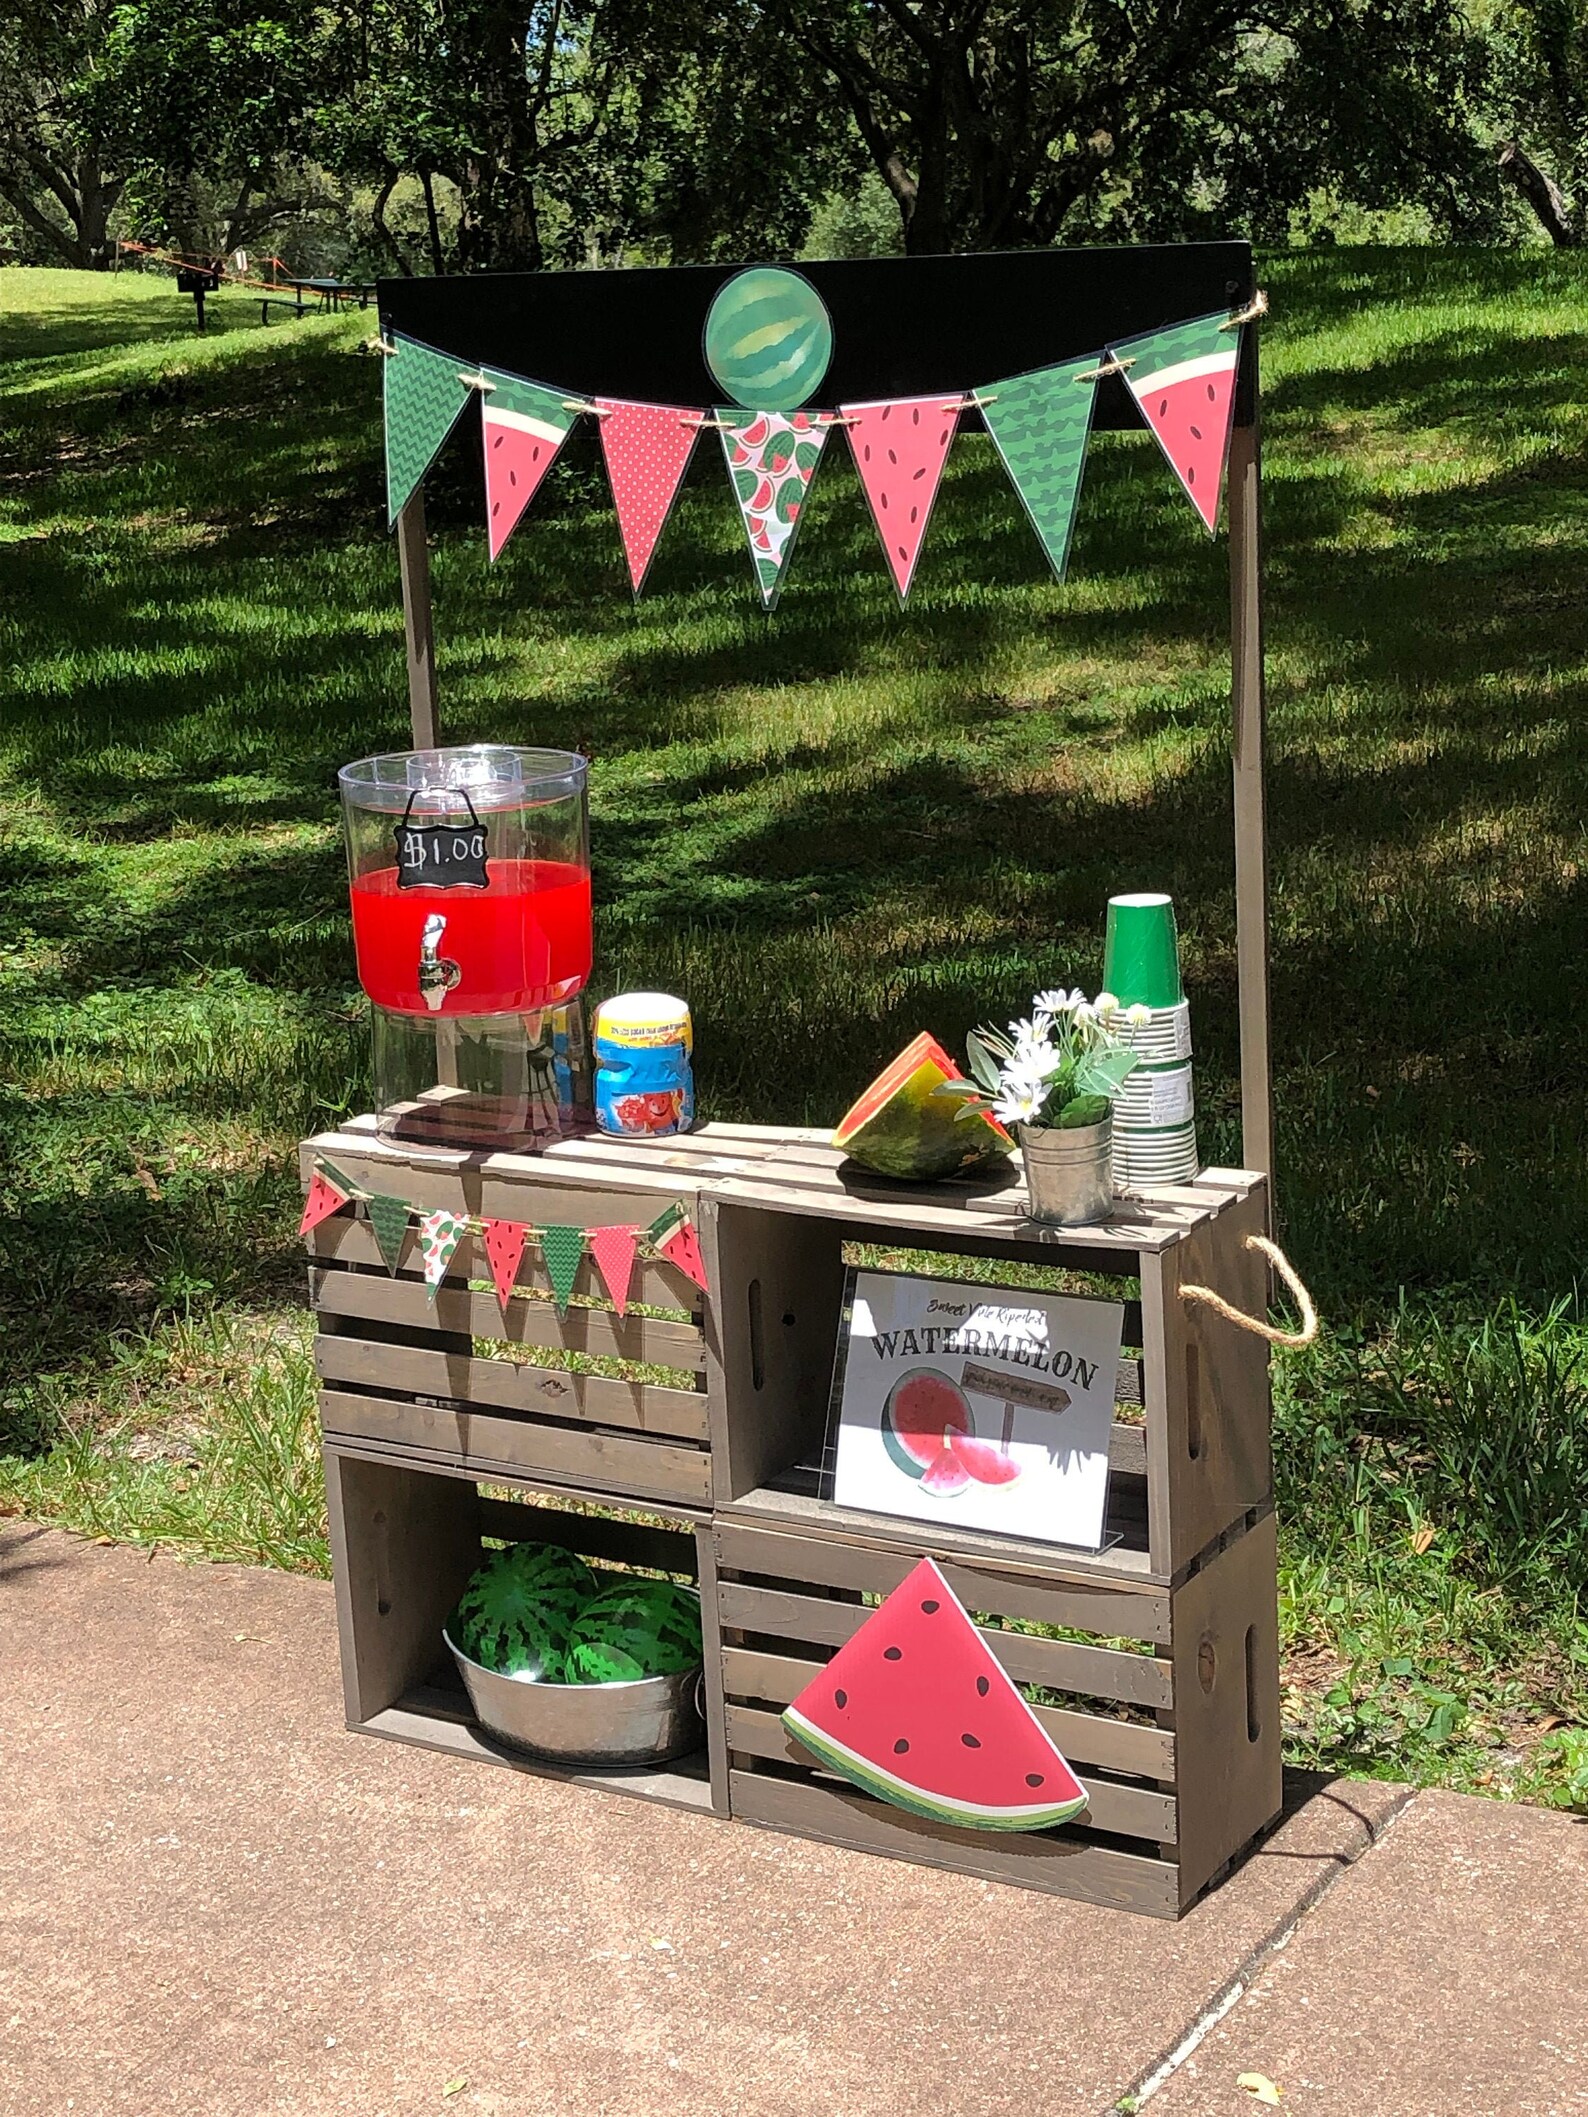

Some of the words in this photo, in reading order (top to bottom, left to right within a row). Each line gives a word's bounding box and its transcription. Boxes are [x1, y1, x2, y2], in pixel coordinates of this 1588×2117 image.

[403, 832, 484, 871] $1.00
[926, 1299, 966, 1317] Sweet
[870, 1326, 1100, 1391] WATERMELON
